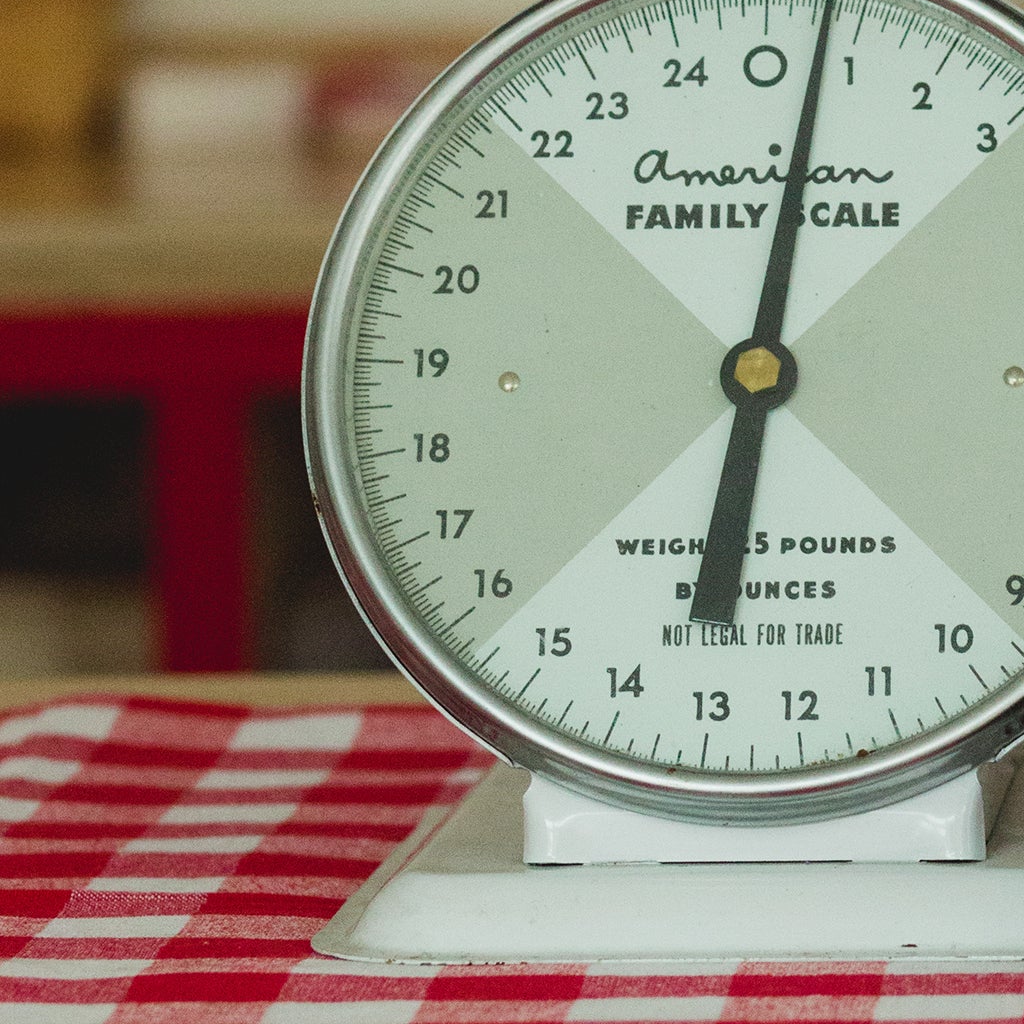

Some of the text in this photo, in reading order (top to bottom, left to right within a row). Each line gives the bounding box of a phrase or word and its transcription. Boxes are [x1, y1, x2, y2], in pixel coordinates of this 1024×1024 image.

[663, 57, 709, 88] 24
[843, 55, 856, 86] 1
[586, 91, 629, 120] 23
[912, 82, 933, 110] 2
[531, 130, 574, 158] 22
[976, 123, 998, 153] 3
[633, 143, 894, 187] Amerian
[475, 190, 508, 219] 21
[626, 202, 769, 230] FAMILY
[434, 264, 480, 294] 20
[414, 348, 450, 378] 19
[413, 433, 450, 463] 18
[435, 509, 474, 540] 17
[742, 531, 770, 555] 5
[780, 536, 897, 555] POUNDS
[474, 569, 513, 598] 16
[738, 580, 837, 601] UNCES
[535, 627, 572, 657] 15
[662, 622, 843, 647] NOT LEGAL FOR TRADE
[934, 623, 974, 654] 10
[606, 667, 645, 698] 14
[865, 666, 892, 696] 11
[692, 691, 730, 722] 13
[781, 690, 819, 721] 12
